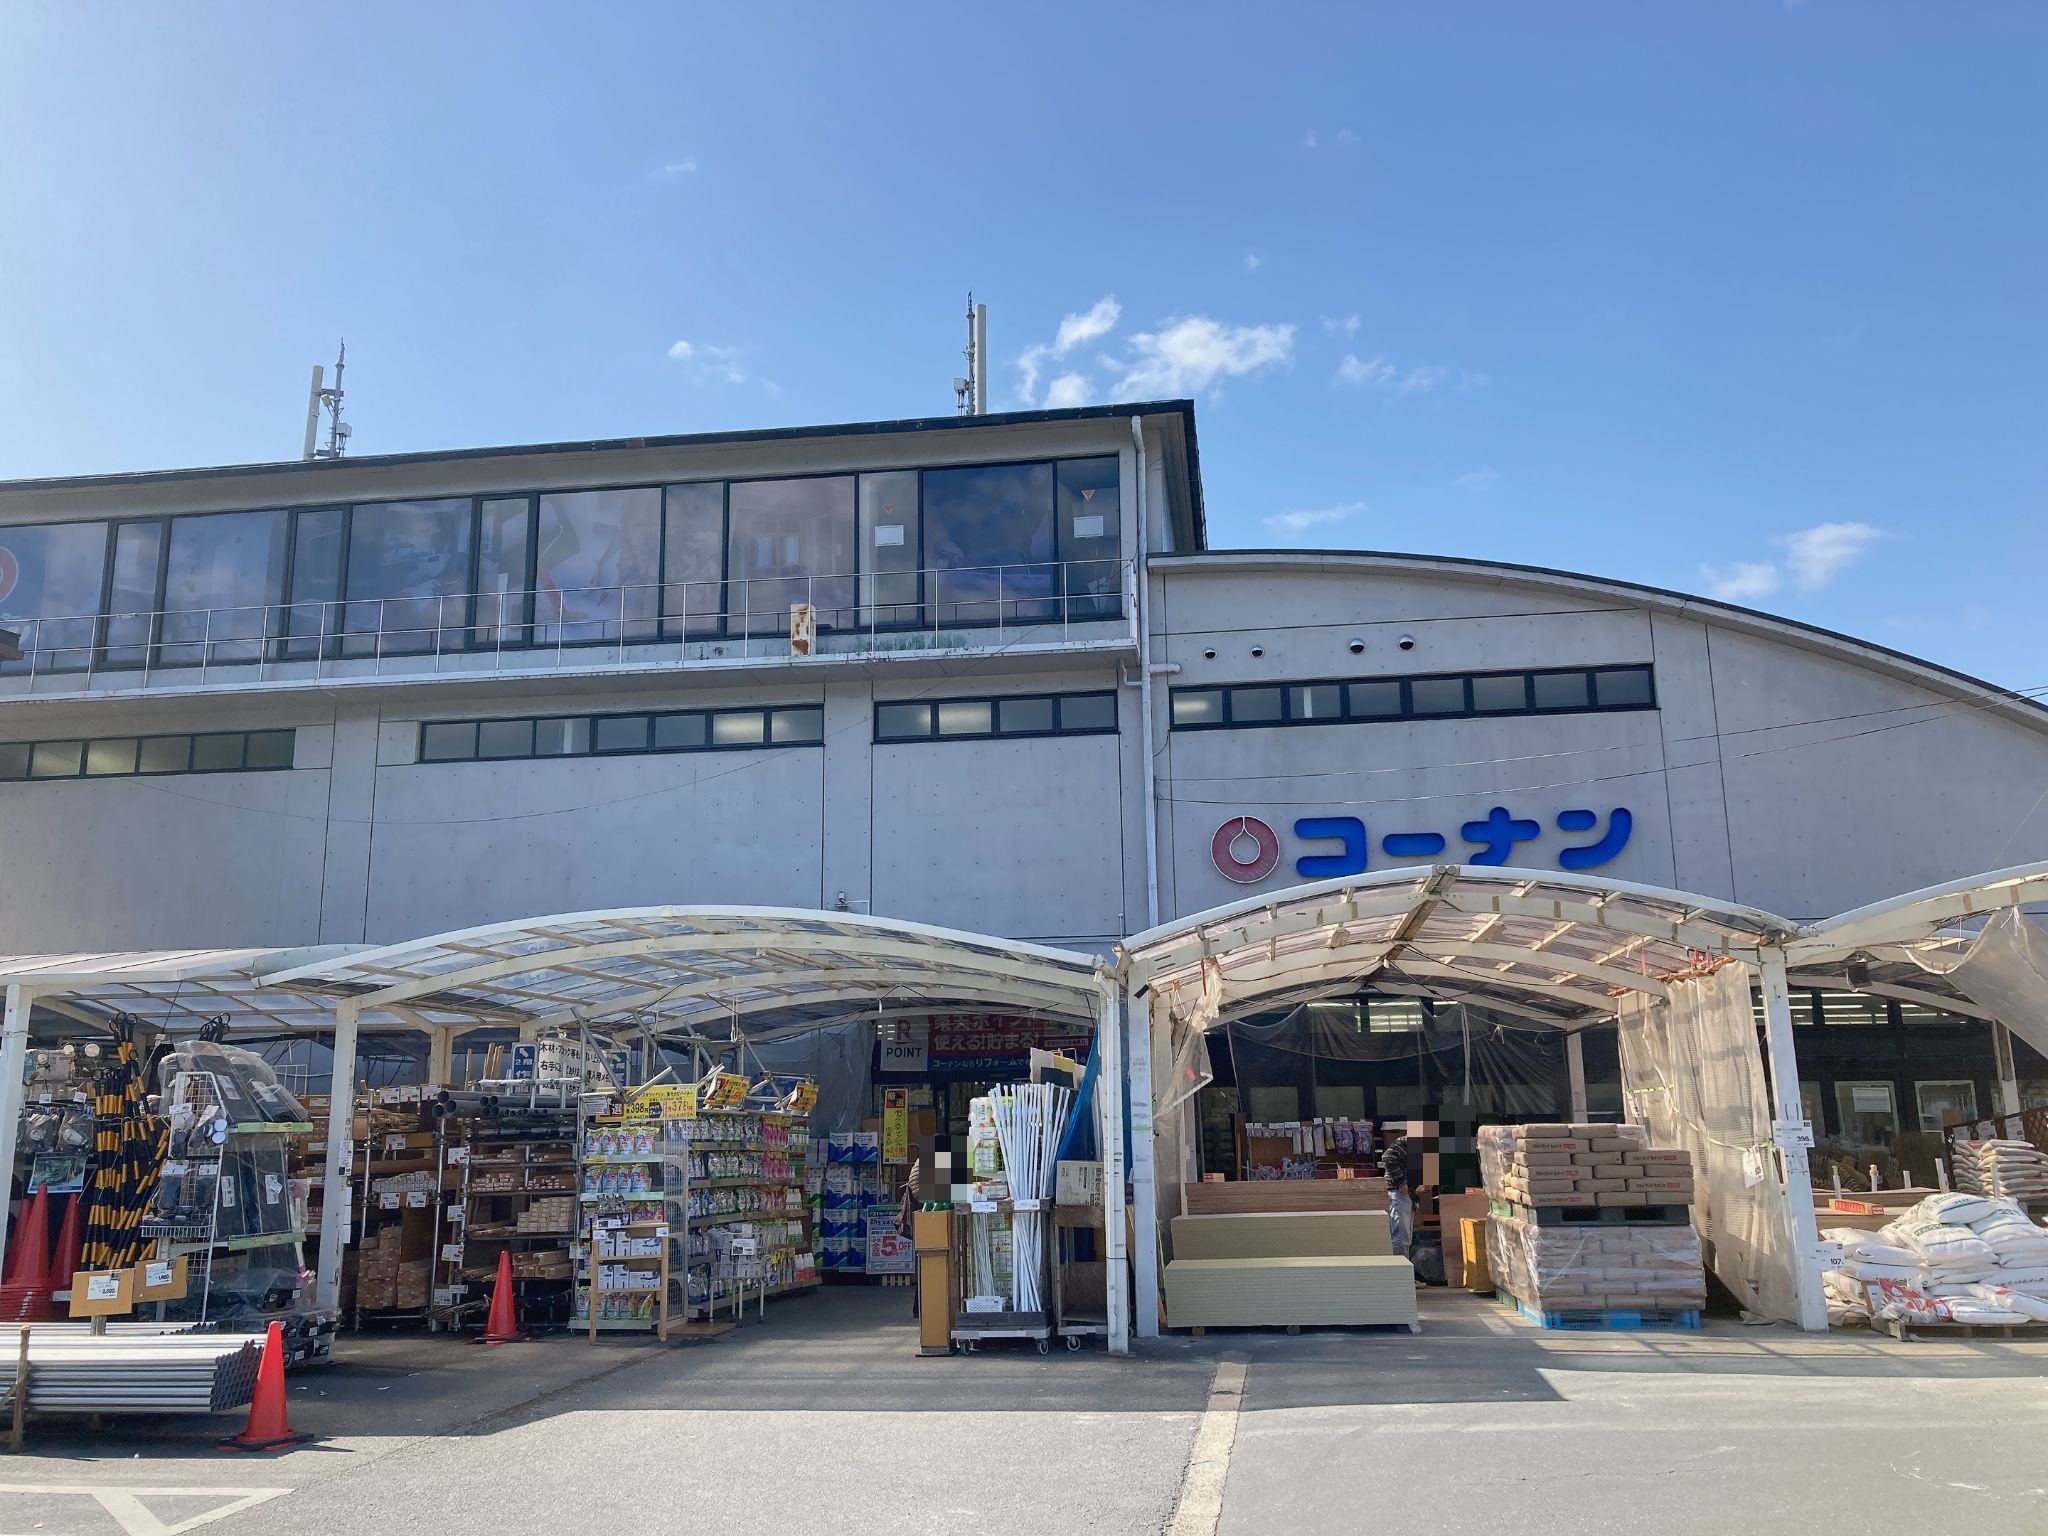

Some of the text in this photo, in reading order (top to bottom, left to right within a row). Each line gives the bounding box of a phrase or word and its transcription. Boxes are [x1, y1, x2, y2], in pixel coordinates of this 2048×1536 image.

[1294, 807, 1632, 877] コーナン
[886, 1047, 923, 1058] POINT
